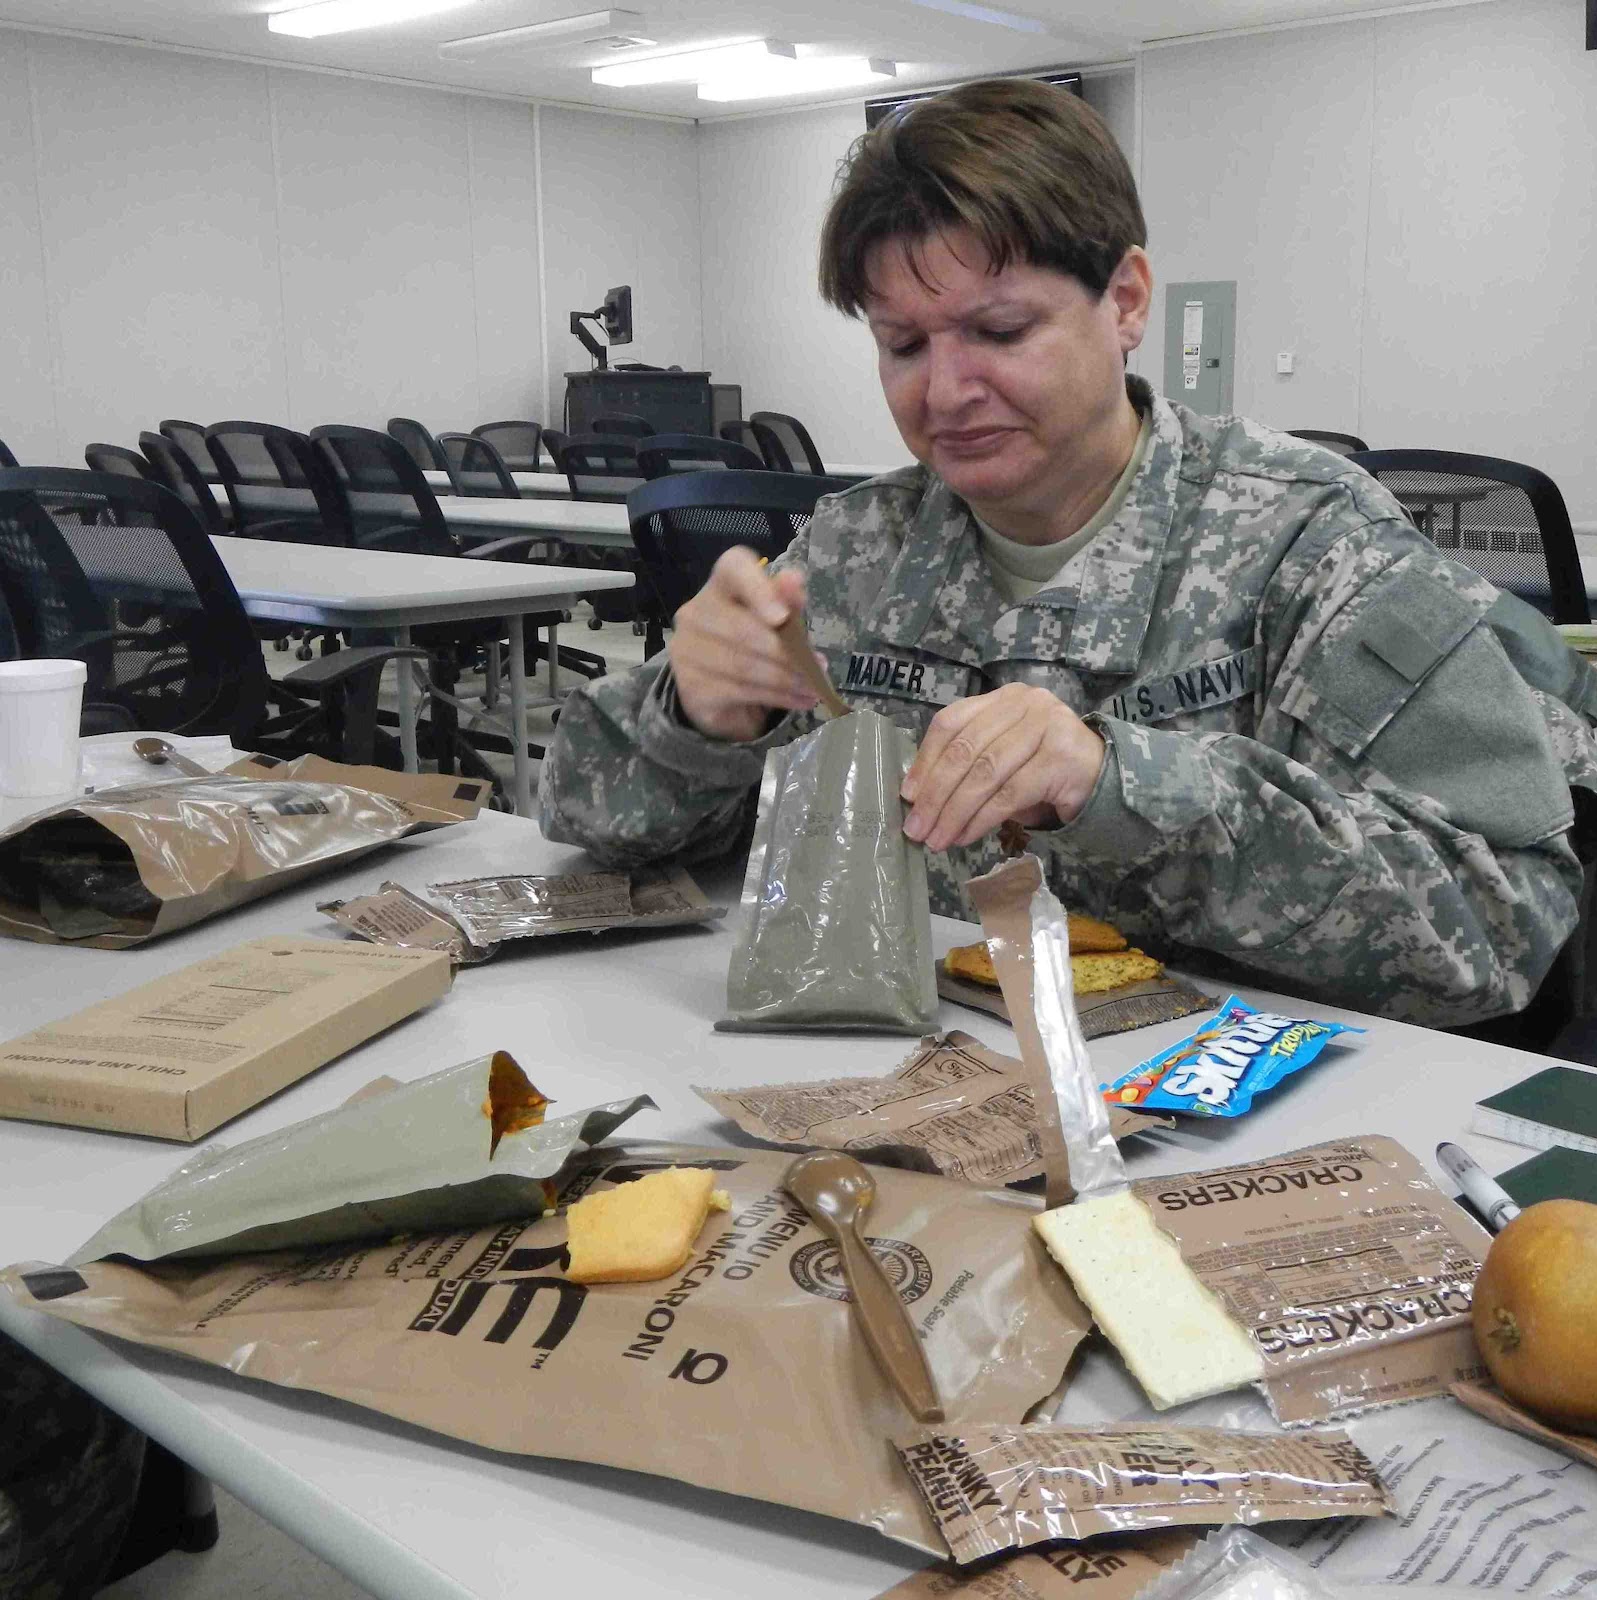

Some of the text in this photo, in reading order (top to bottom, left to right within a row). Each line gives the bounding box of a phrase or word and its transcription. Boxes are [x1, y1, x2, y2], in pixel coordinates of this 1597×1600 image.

[846, 654, 925, 693] MADER
[1112, 655, 1247, 721] U.S. NAVY
[2, 1053, 187, 1076] CHILI AND MACARONI
[1157, 1164, 1364, 1212] CRACKERS
[748, 1202, 810, 1270] MENU
[622, 1194, 772, 1361] AND MACARONI
[938, 1269, 975, 1310] Peelable
[1256, 1288, 1474, 1355] CRACKERS
[905, 1443, 971, 1524] PEANUT
[932, 1435, 1003, 1512] CHUNKY
